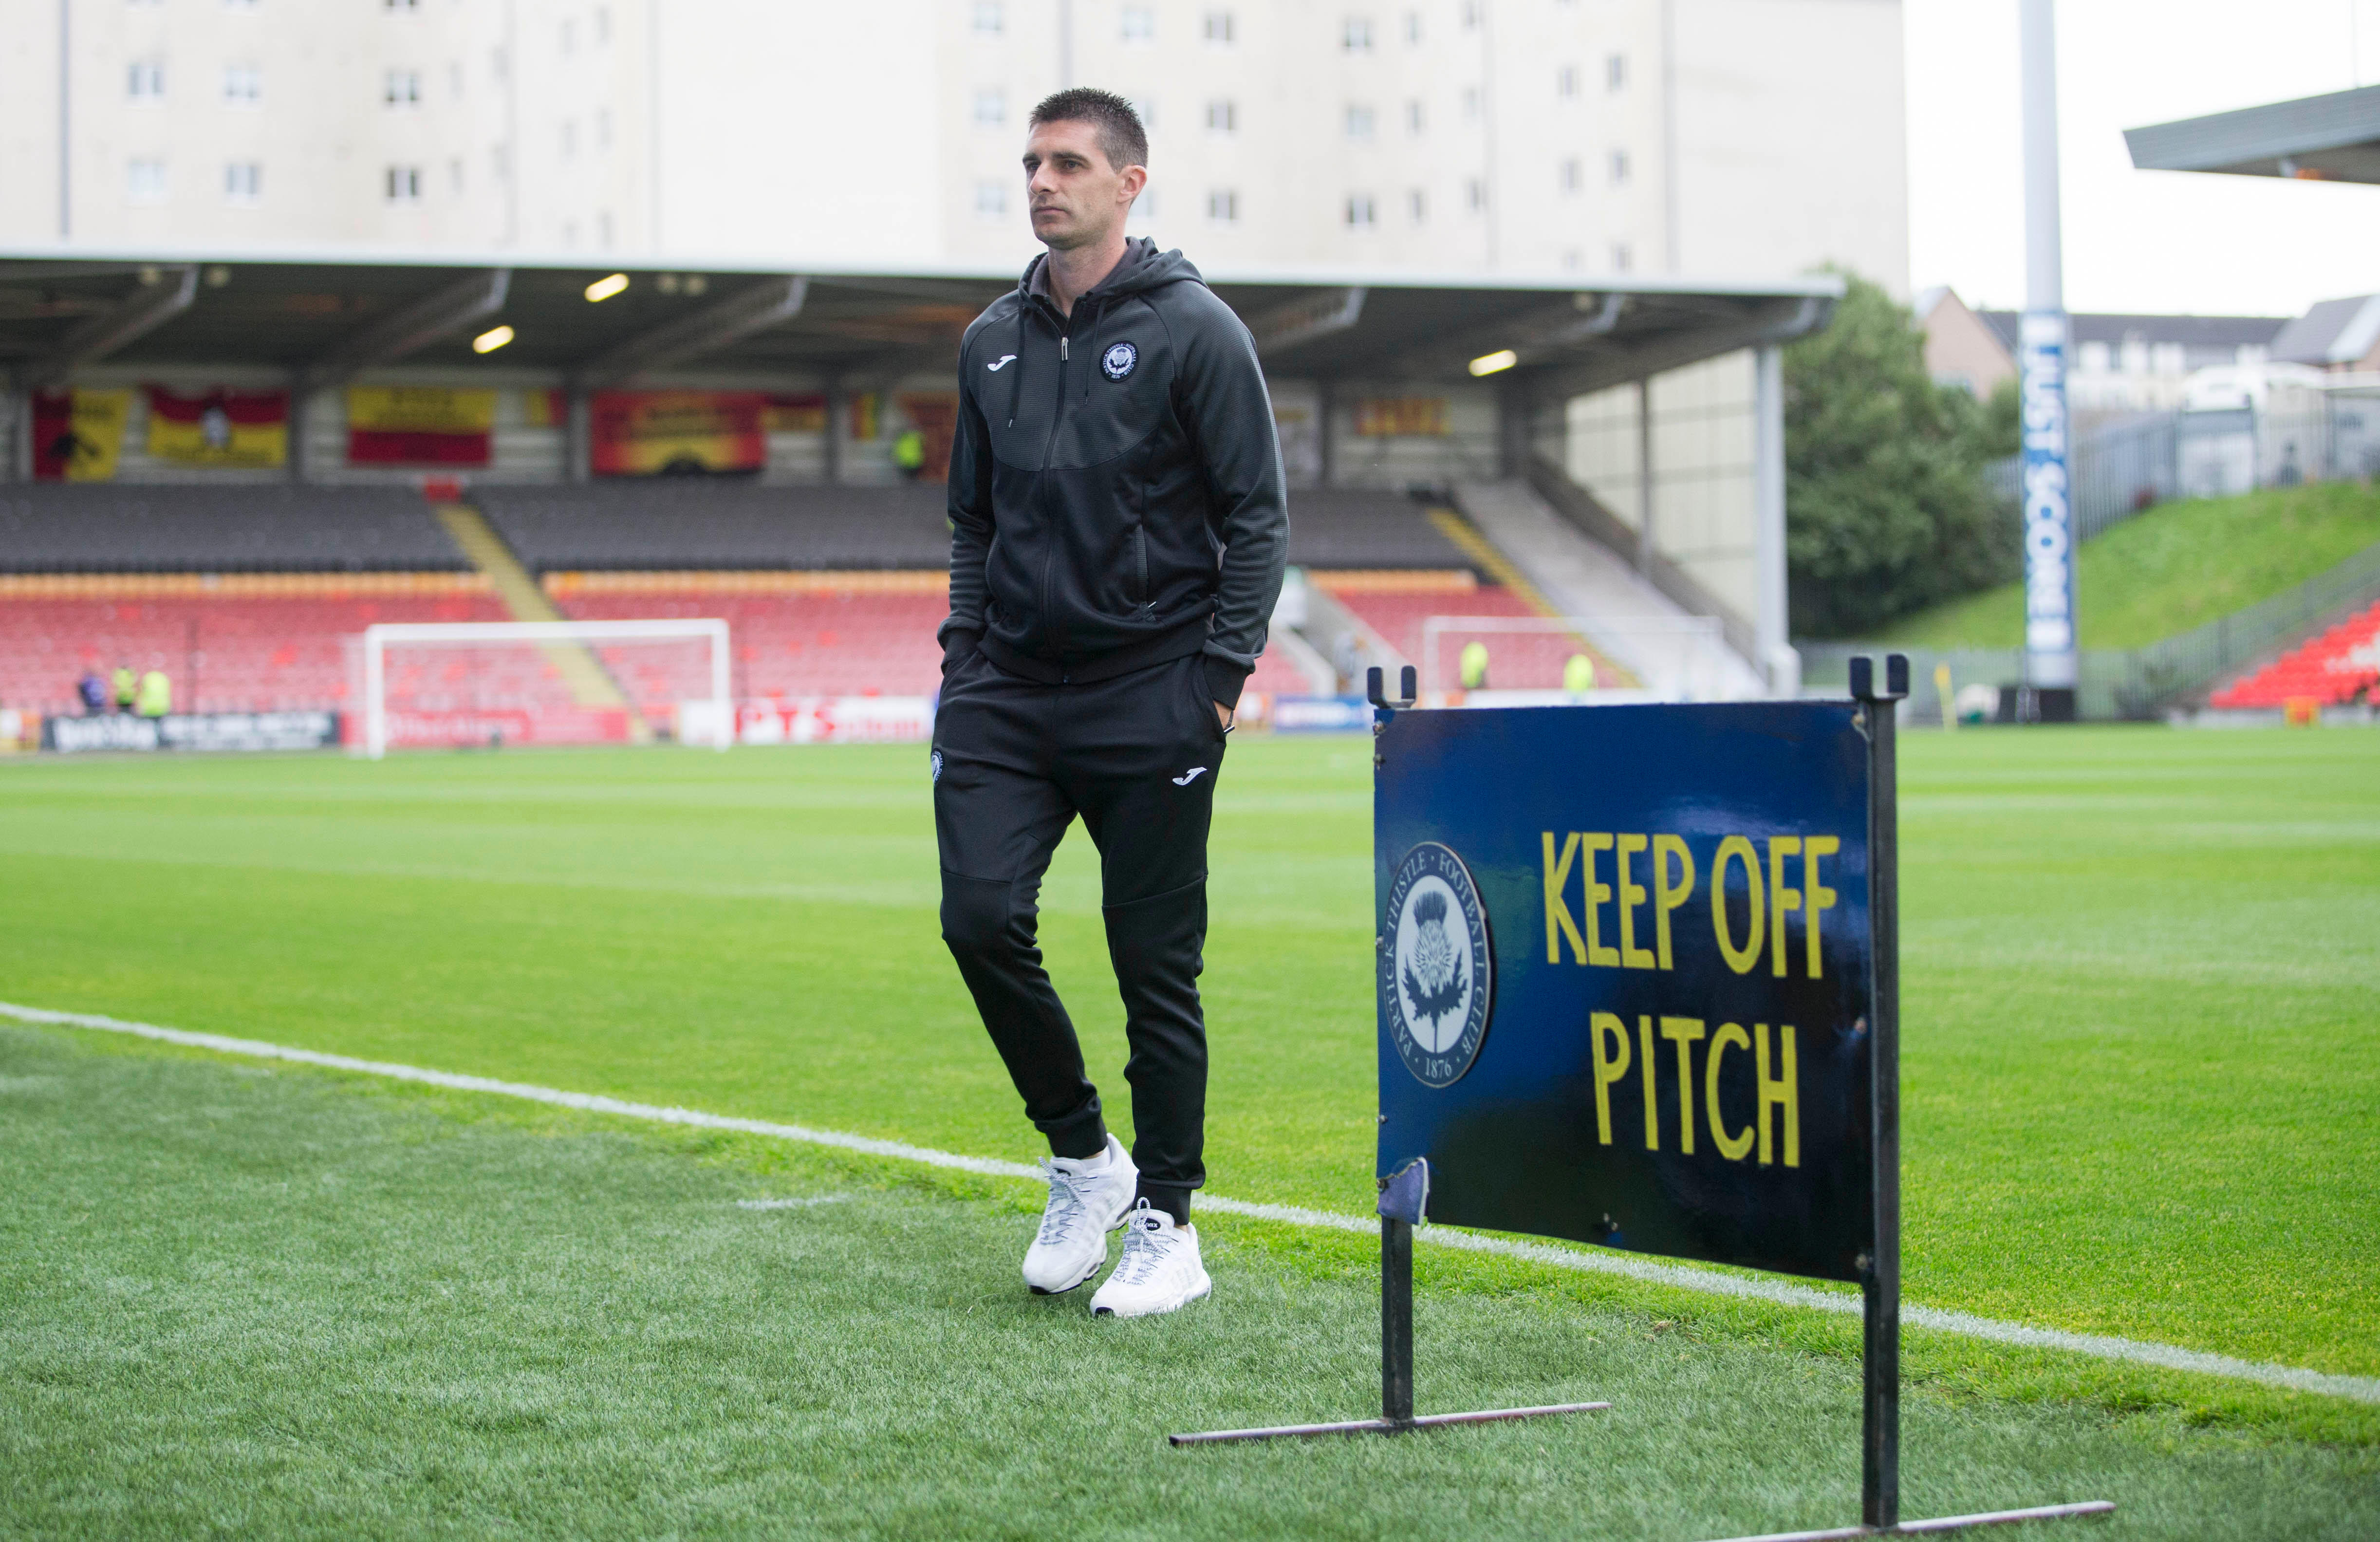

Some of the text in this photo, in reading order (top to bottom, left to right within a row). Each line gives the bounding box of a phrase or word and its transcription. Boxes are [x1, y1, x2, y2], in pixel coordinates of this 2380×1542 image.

[1107, 344, 1123, 354] THISTLE
[1124, 364, 1134, 375] CLUB
[1385, 852, 1485, 1057] PARTICK THISTLE FOOTBALL CLUB
[1542, 831, 1840, 979] KEEP OFF
[1425, 1057, 1452, 1078] 1876
[1590, 1011, 1799, 1168] PITCH
